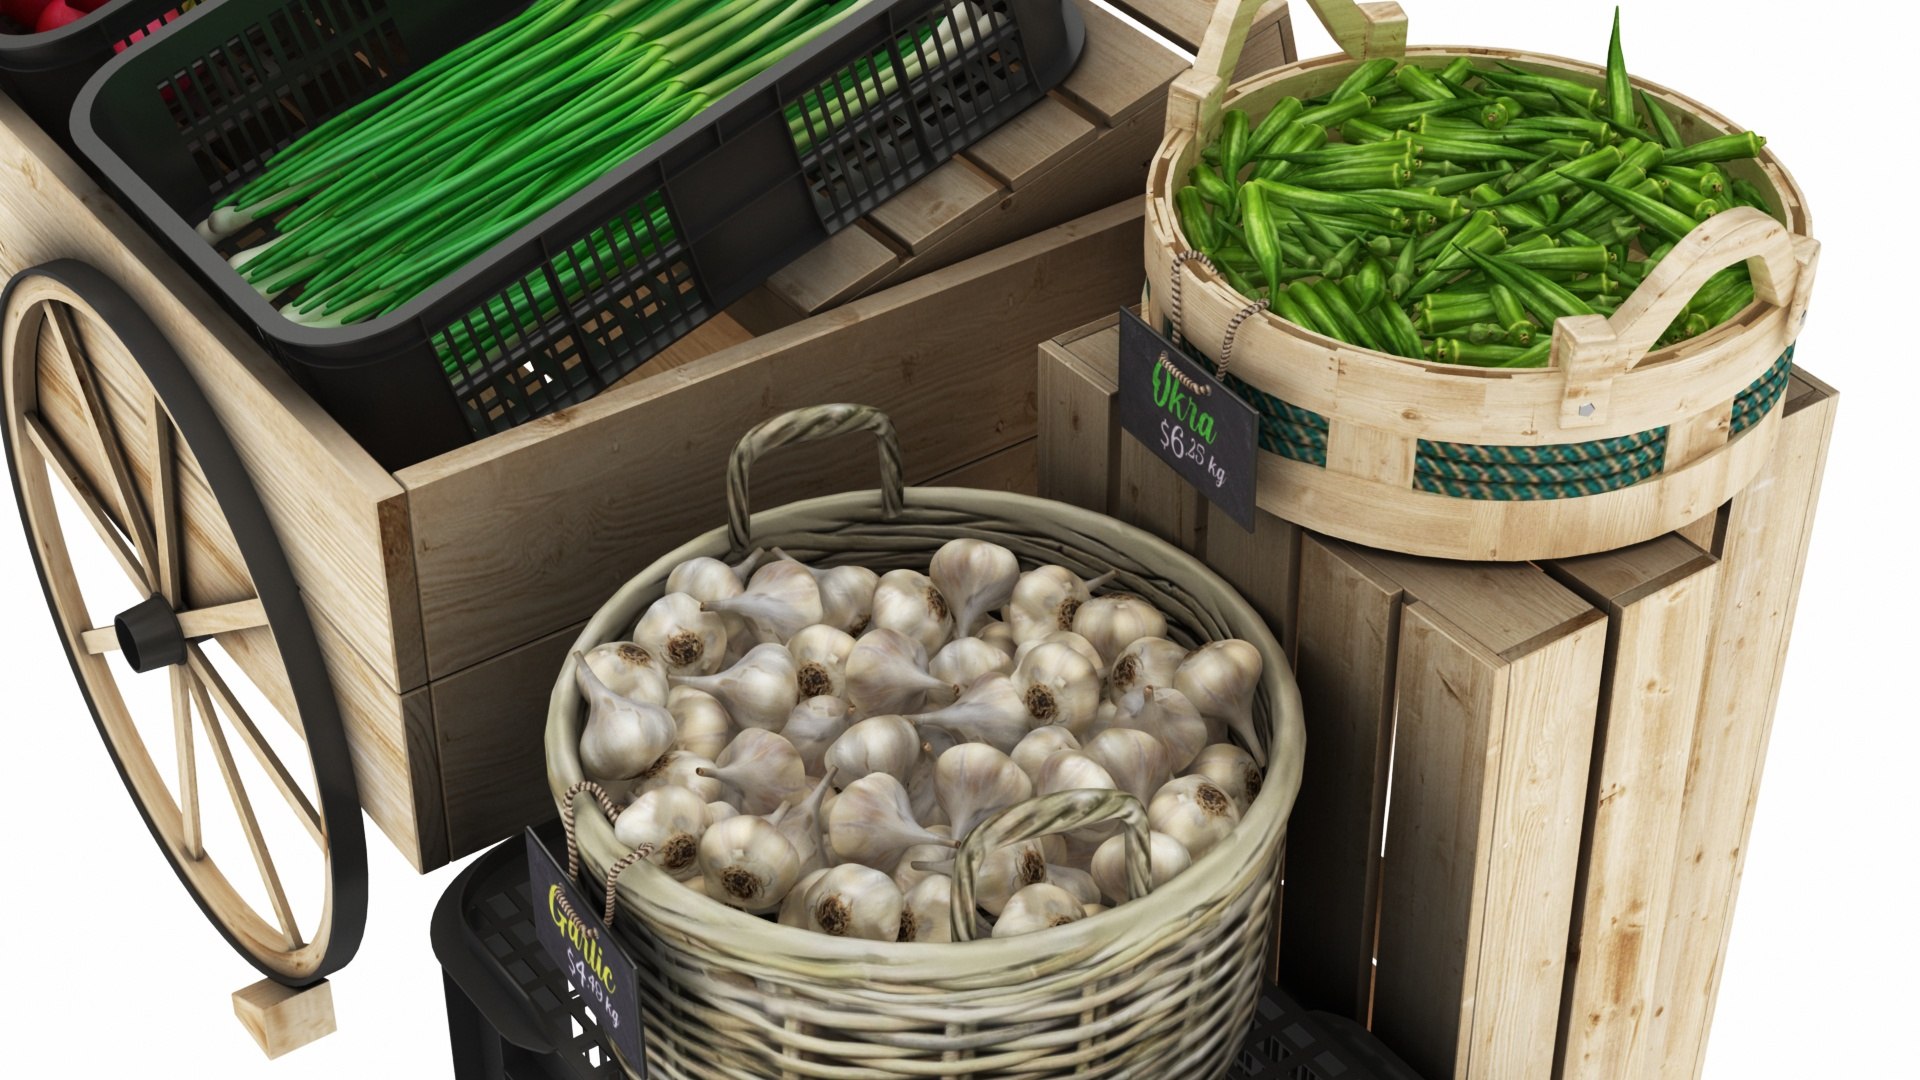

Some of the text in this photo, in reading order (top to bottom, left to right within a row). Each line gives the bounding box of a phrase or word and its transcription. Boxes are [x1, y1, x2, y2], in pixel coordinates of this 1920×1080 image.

[1152, 360, 1217, 445] Okra
[1160, 418, 1226, 488] $6.25 kg
[549, 884, 616, 994] Garlic
[605, 997, 620, 1029] kg
